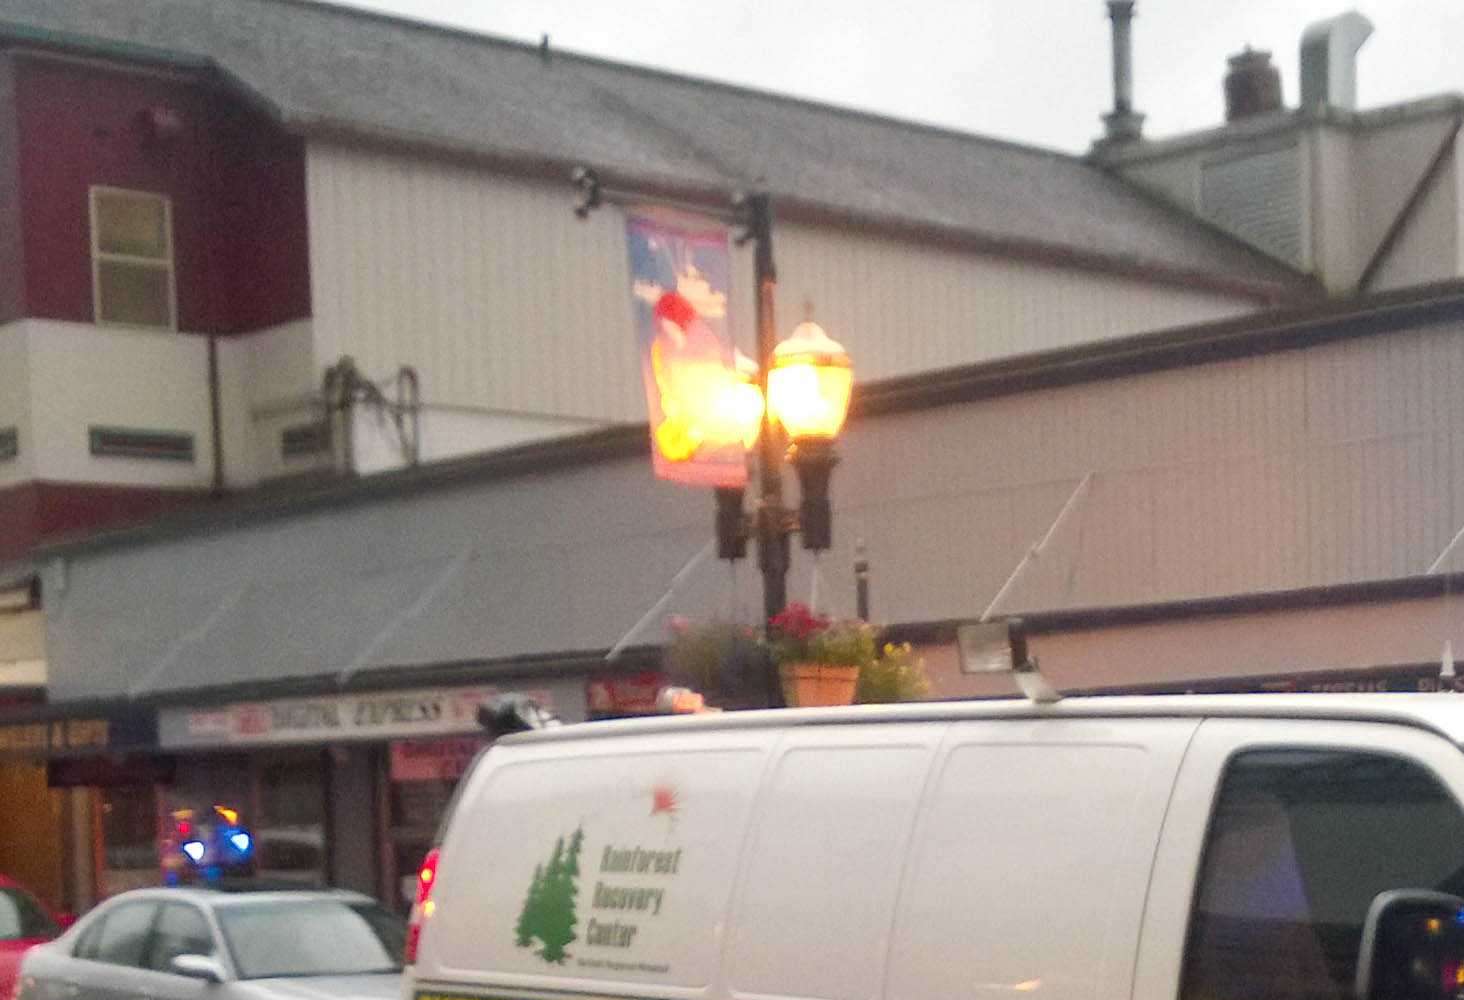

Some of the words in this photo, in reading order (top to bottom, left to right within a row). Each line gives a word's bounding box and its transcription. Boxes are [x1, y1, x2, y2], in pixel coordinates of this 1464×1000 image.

[600, 844, 682, 874] Rainforest
[592, 881, 665, 916] Recovery
[586, 917, 638, 948] Center
